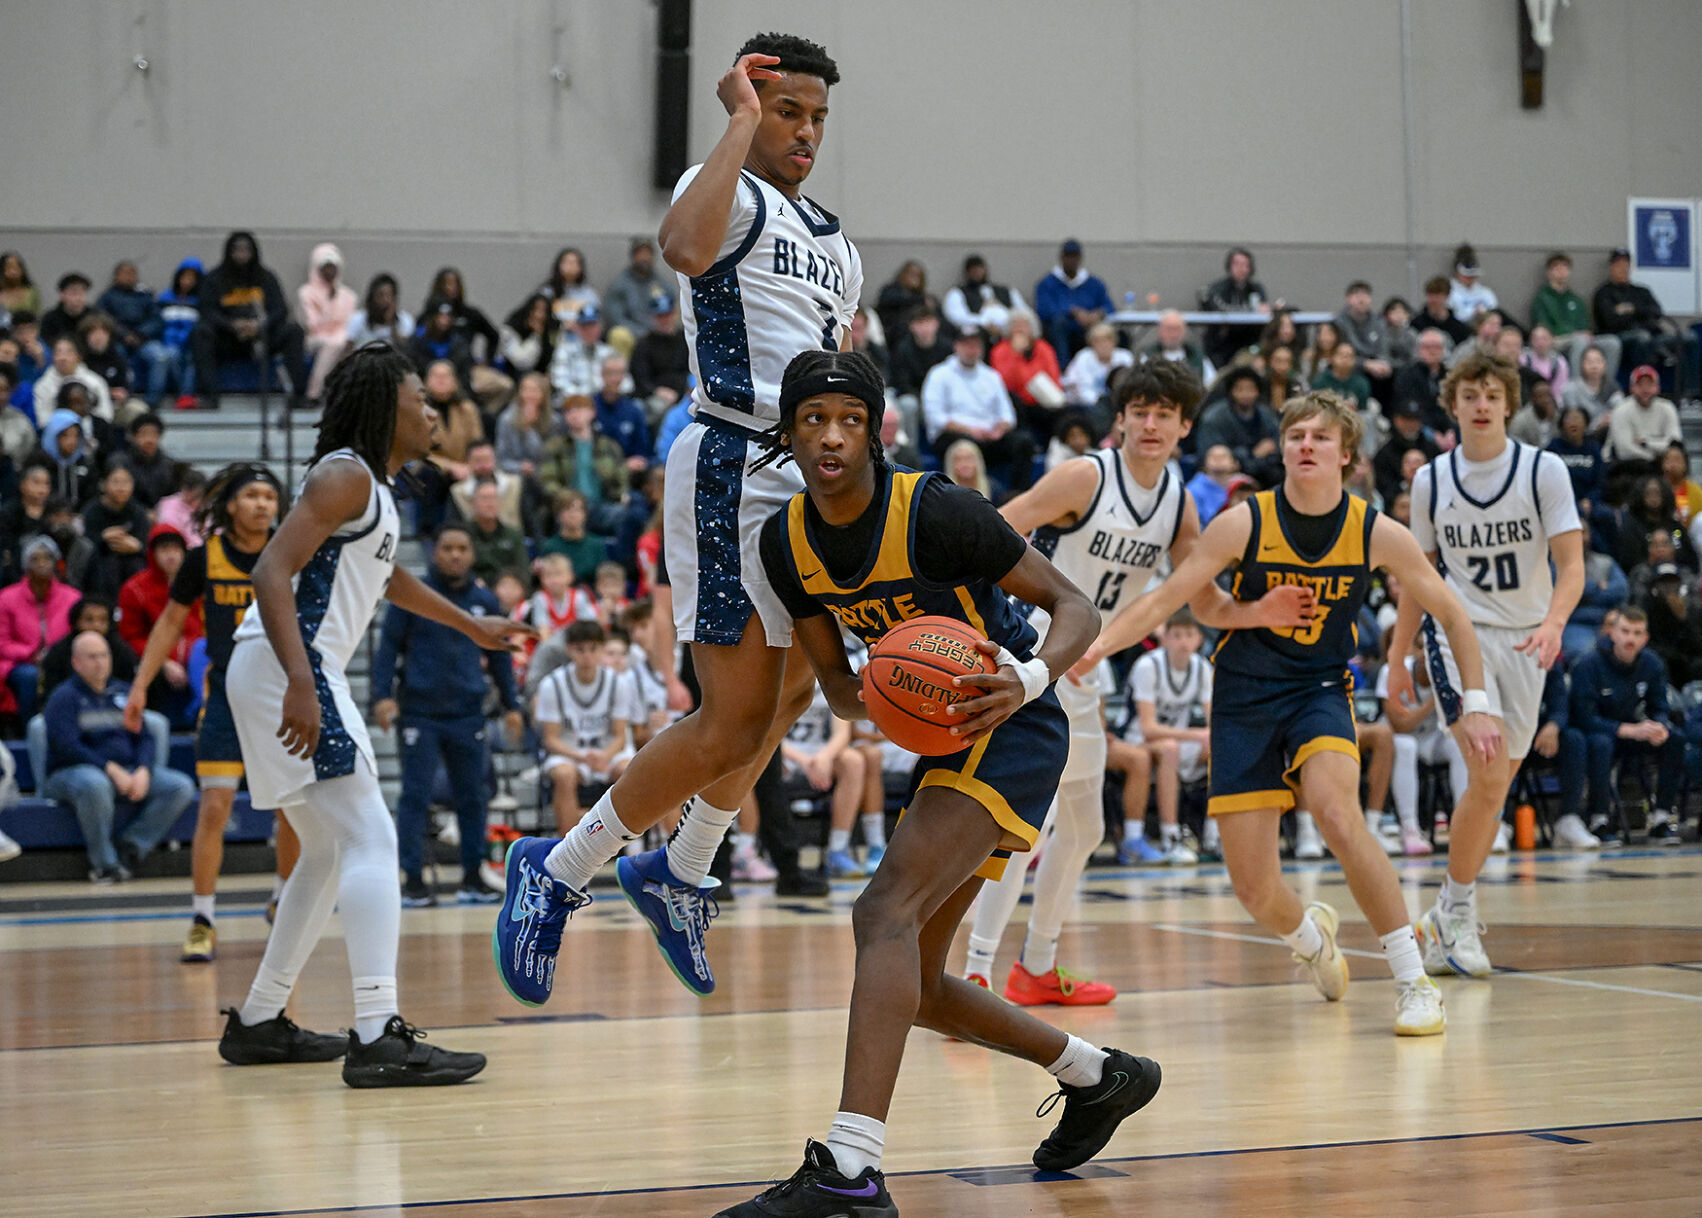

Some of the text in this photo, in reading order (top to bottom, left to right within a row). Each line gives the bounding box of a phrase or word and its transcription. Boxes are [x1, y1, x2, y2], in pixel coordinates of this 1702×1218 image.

[1088, 530, 1163, 569] BLAZERS
[1443, 518, 1533, 549] BLAZERS
[1265, 570, 1356, 601] BATTLE
[1467, 551, 1520, 592] 20
[1094, 571, 1128, 611] 13
[907, 640, 986, 673] LEGACY
